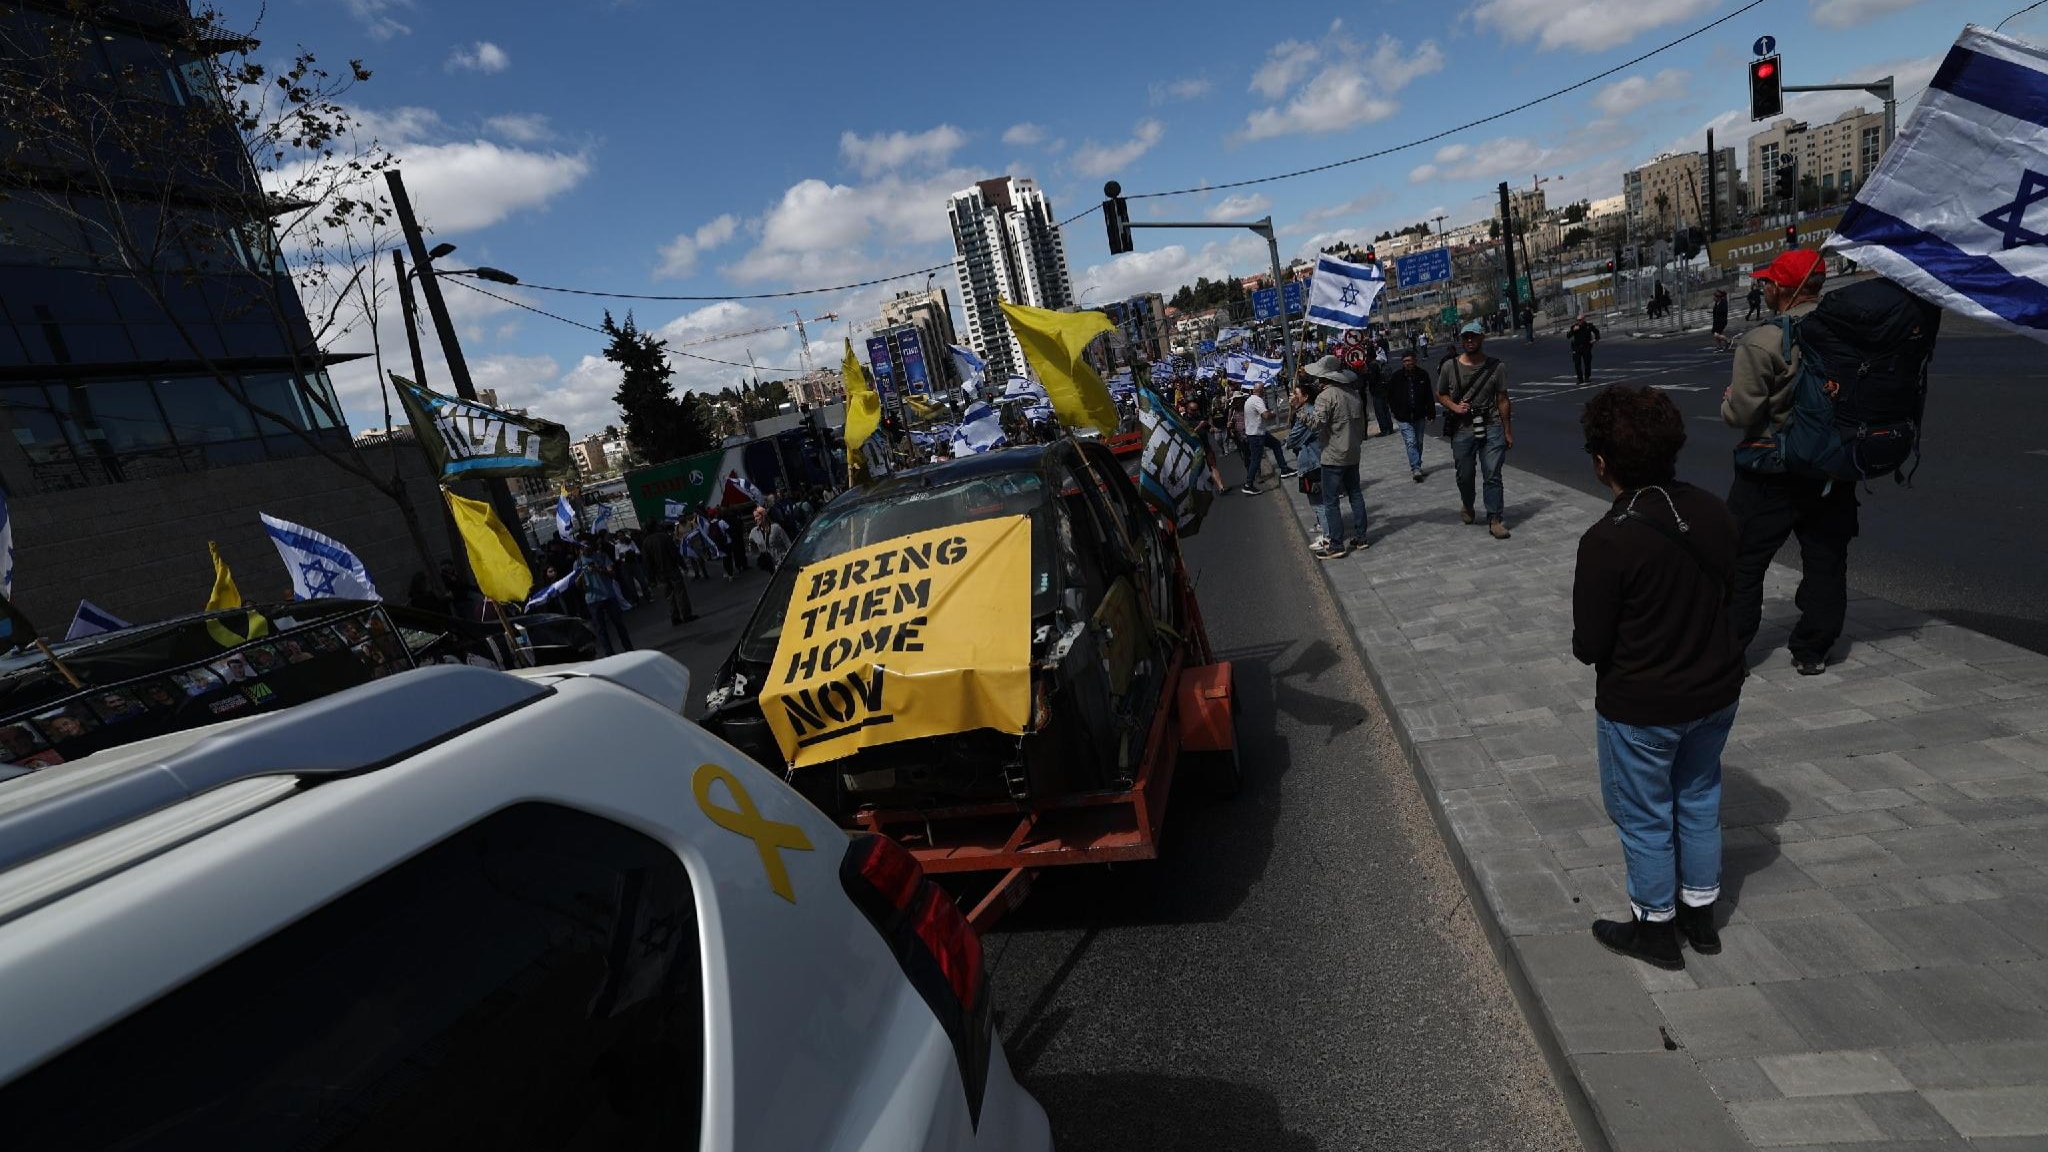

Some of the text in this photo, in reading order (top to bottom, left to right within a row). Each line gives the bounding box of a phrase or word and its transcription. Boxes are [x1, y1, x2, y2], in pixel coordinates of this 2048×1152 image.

[1728, 241, 1774, 260] עבודה
[808, 536, 968, 602] BRING
[801, 579, 932, 639] THEM
[785, 616, 928, 684] HOME
